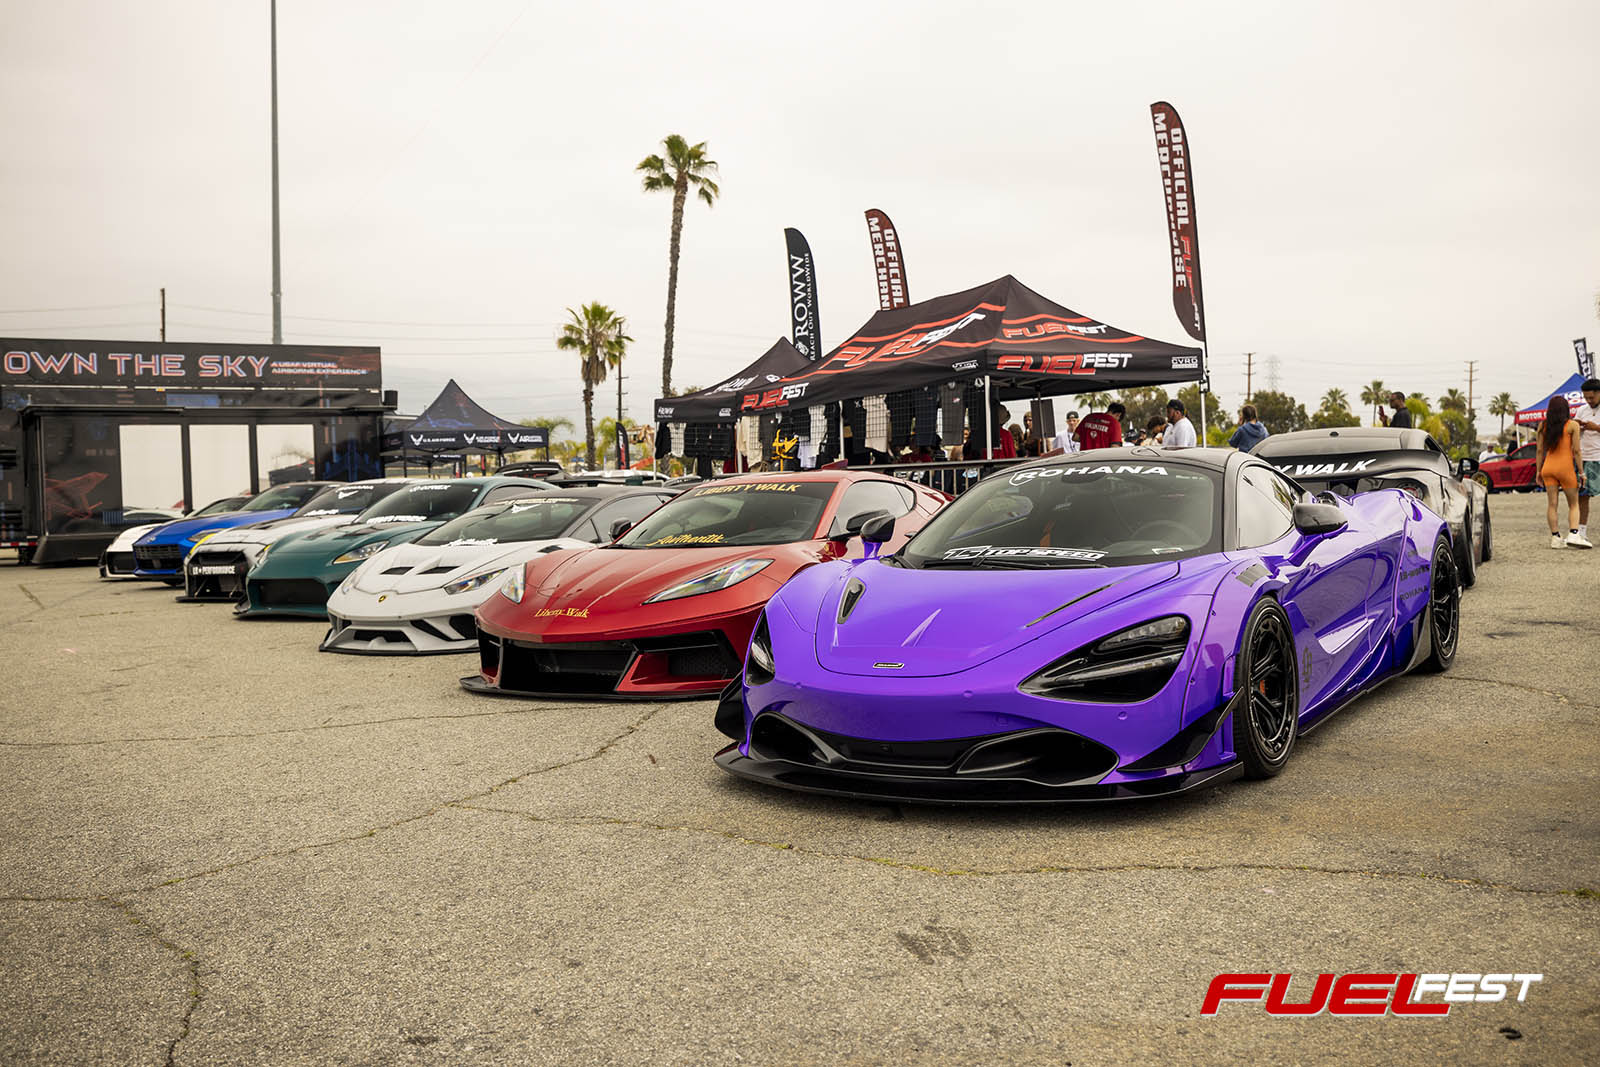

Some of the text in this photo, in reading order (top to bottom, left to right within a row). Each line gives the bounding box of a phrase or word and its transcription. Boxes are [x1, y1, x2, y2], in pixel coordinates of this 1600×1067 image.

[1170, 128, 1190, 230] OFFICIAL
[883, 229, 905, 308] OFFICIAL
[804, 253, 812, 307] WORLDWIDE
[790, 254, 809, 337] ROWW
[1002, 322, 1108, 338] FUELFEST
[4, 351, 269, 378] OWN THE SKY
[996, 353, 1133, 375] FUELFEST
[740, 382, 810, 412] FUELFEST
[1519, 412, 1543, 420] MOTOR
[1015, 465, 1168, 482] ROHANA
[1294, 458, 1377, 476] WALK
[694, 483, 801, 497] LIBERTY WALK
[534, 607, 590, 618] Liberty Walk
